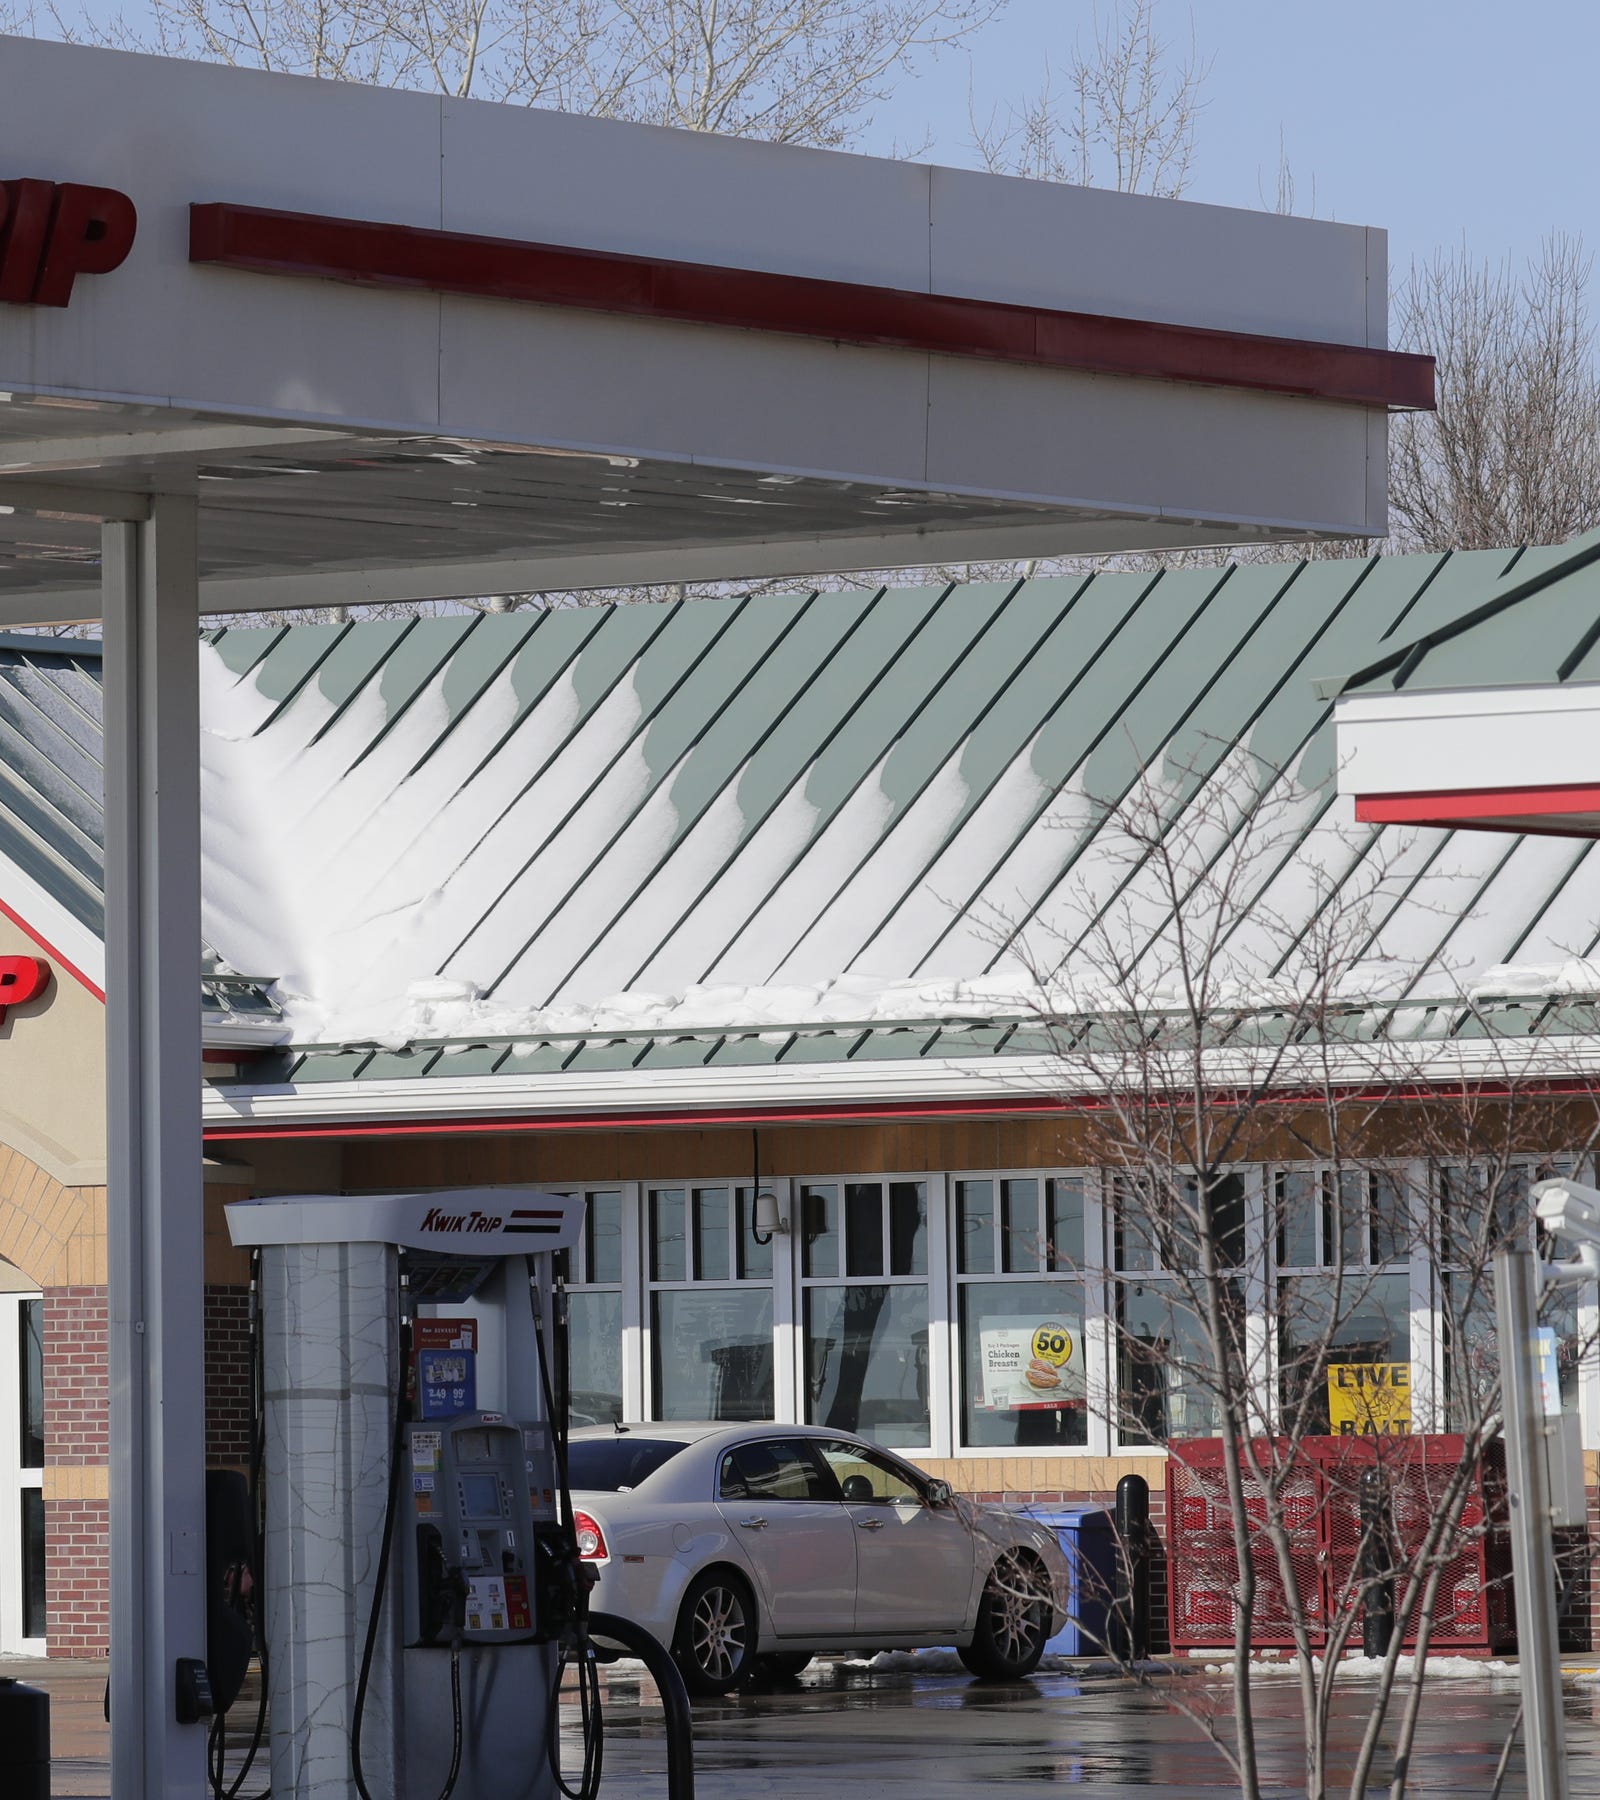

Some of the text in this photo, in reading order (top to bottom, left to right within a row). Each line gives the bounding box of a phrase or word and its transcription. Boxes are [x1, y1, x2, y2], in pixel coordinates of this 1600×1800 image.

[988, 1350, 1020, 1358] Chicken
[988, 1360, 1018, 1368] Breasts
[1337, 1366, 1408, 1388] LIVE
